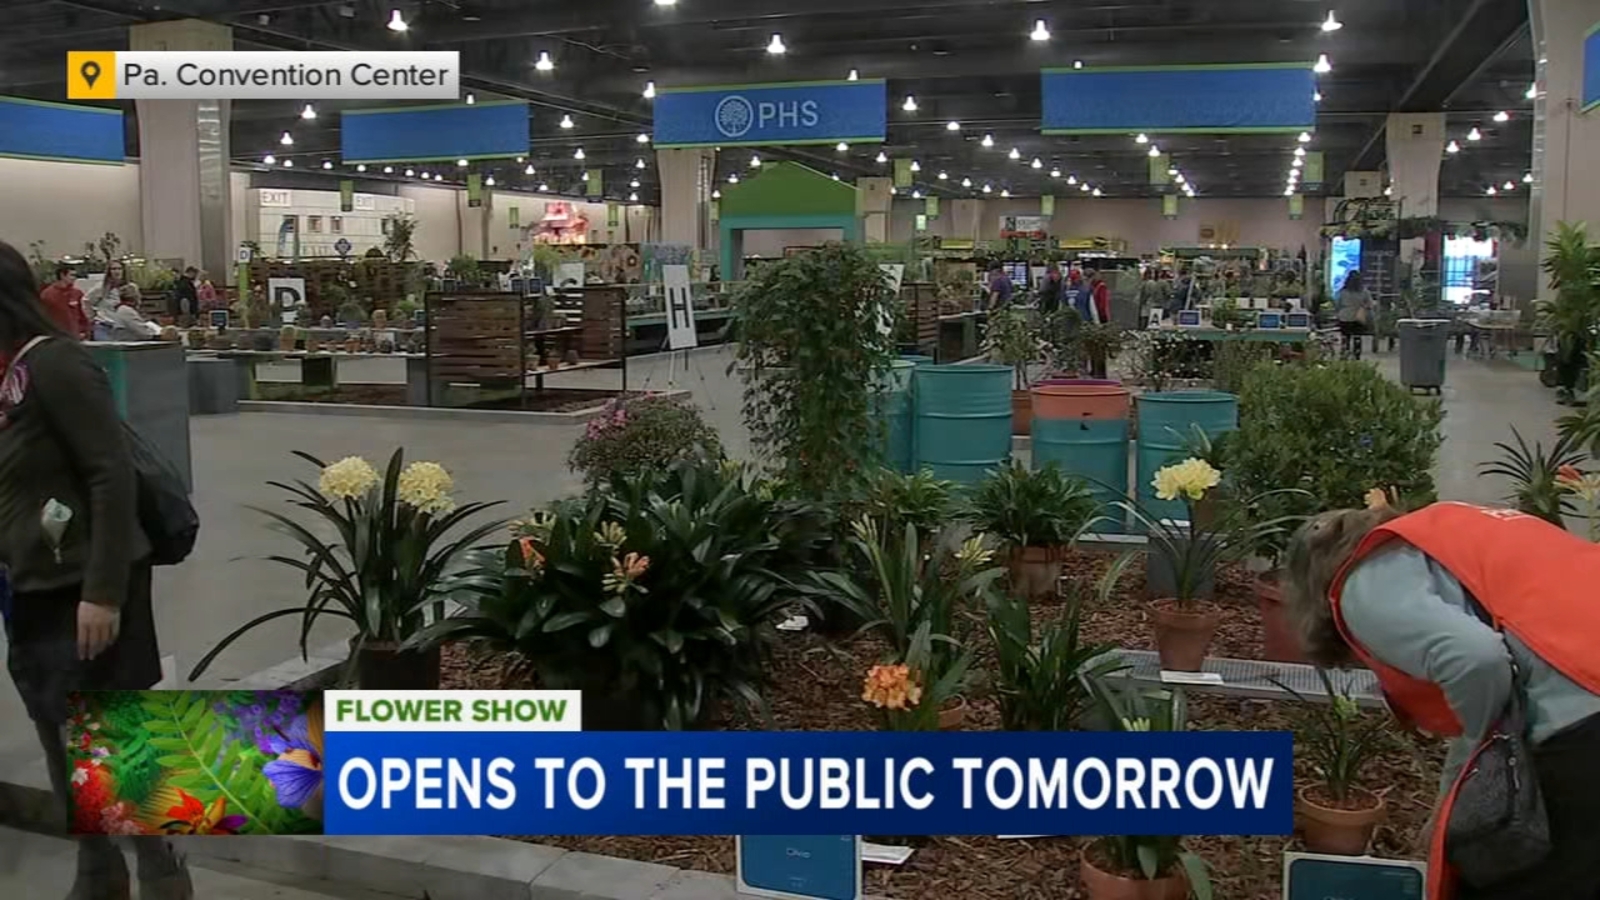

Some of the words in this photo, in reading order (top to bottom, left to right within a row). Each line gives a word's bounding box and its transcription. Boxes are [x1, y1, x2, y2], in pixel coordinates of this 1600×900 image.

[758, 100, 819, 129] PHS
[262, 191, 288, 205] EXIT
[274, 286, 301, 312] D
[669, 287, 690, 329] H
